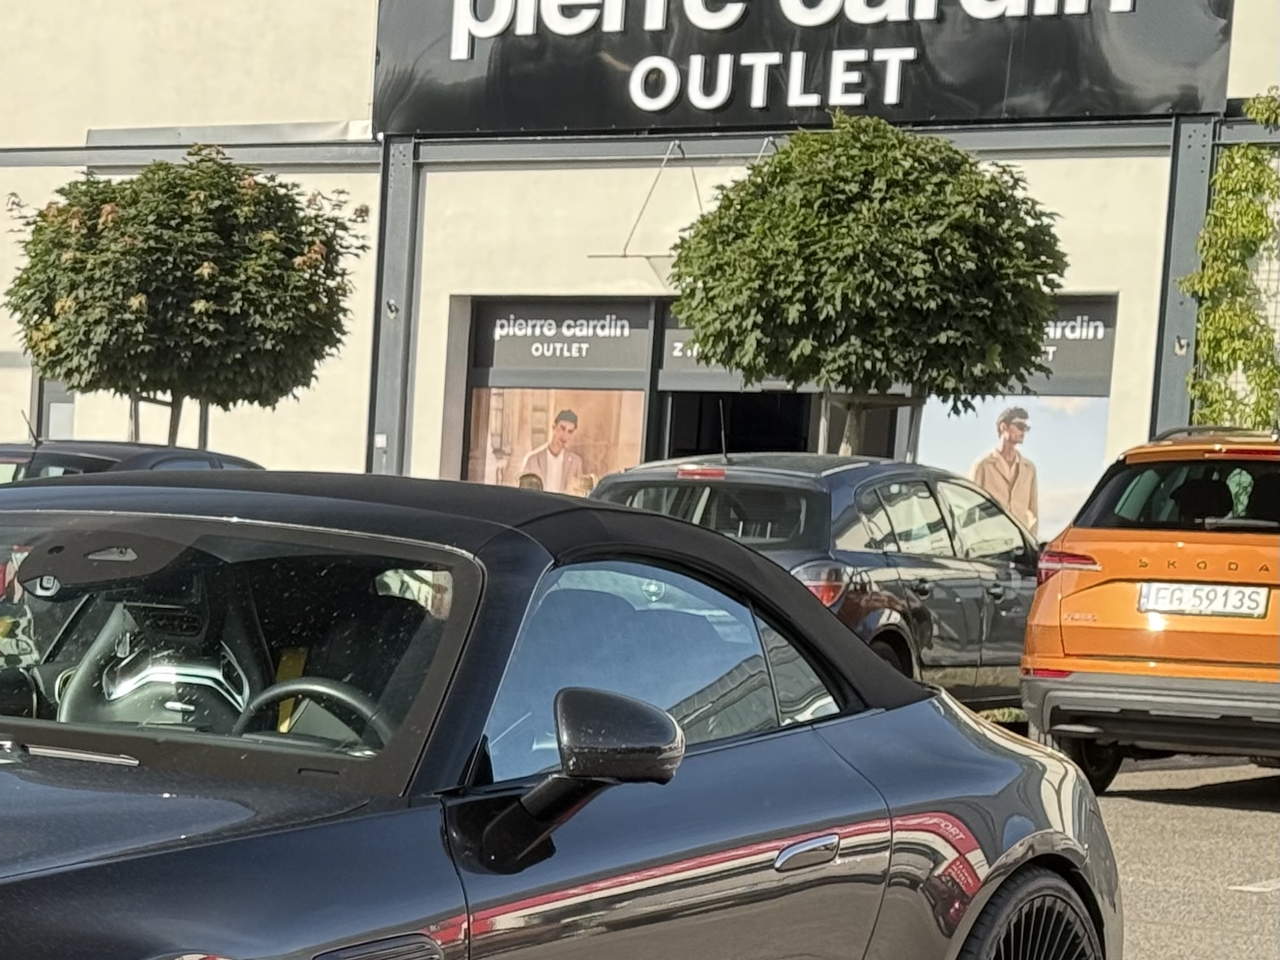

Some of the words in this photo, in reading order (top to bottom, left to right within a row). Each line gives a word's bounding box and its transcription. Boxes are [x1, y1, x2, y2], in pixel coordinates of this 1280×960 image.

[629, 48, 917, 111] OUTLET
[494, 314, 557, 340] pierre
[562, 315, 630, 337] cardin
[1044, 315, 1105, 340] ardin
[531, 342, 590, 358] OUTLET
[1191, 587, 1262, 611] 5913S
